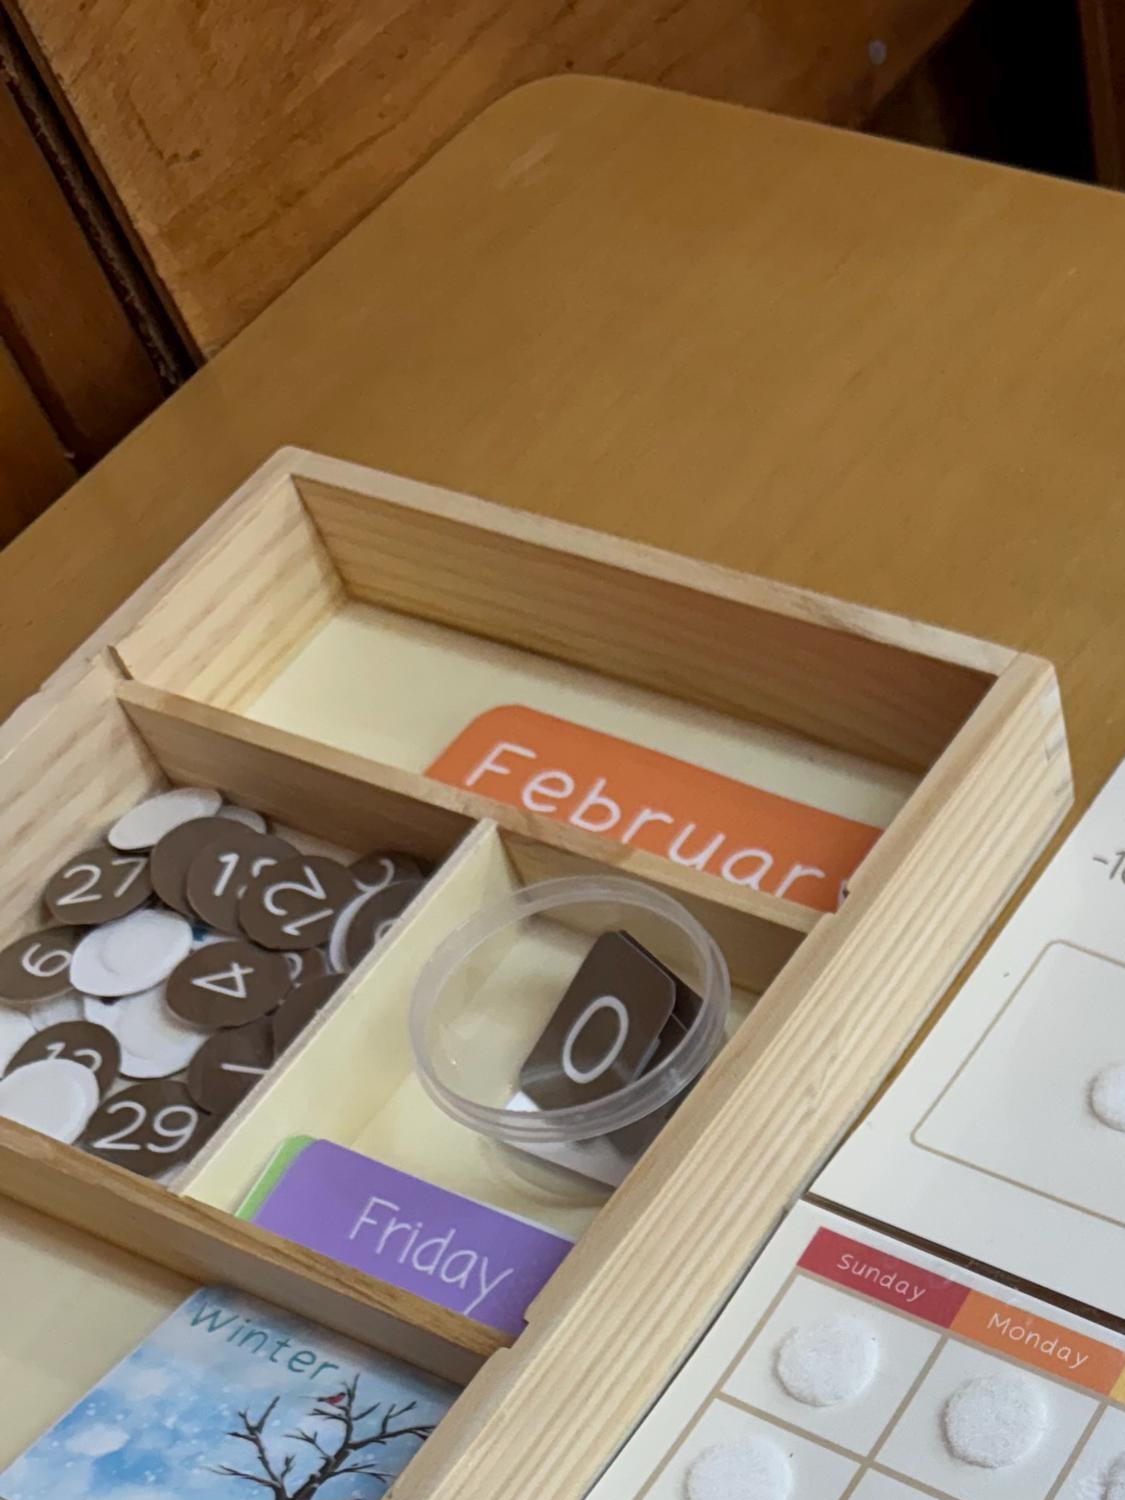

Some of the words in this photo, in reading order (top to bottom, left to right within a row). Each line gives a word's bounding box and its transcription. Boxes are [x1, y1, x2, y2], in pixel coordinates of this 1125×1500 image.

[465, 740, 848, 903] Februar
[62, 858, 147, 902] 27
[191, 962, 255, 998] 4
[562, 996, 629, 1084] 0
[93, 1100, 199, 1153] 29
[348, 1196, 515, 1316] Friday
[189, 1298, 340, 1382] Winter
[837, 1253, 927, 1302] Sunday
[986, 1312, 1090, 1370] Monday
